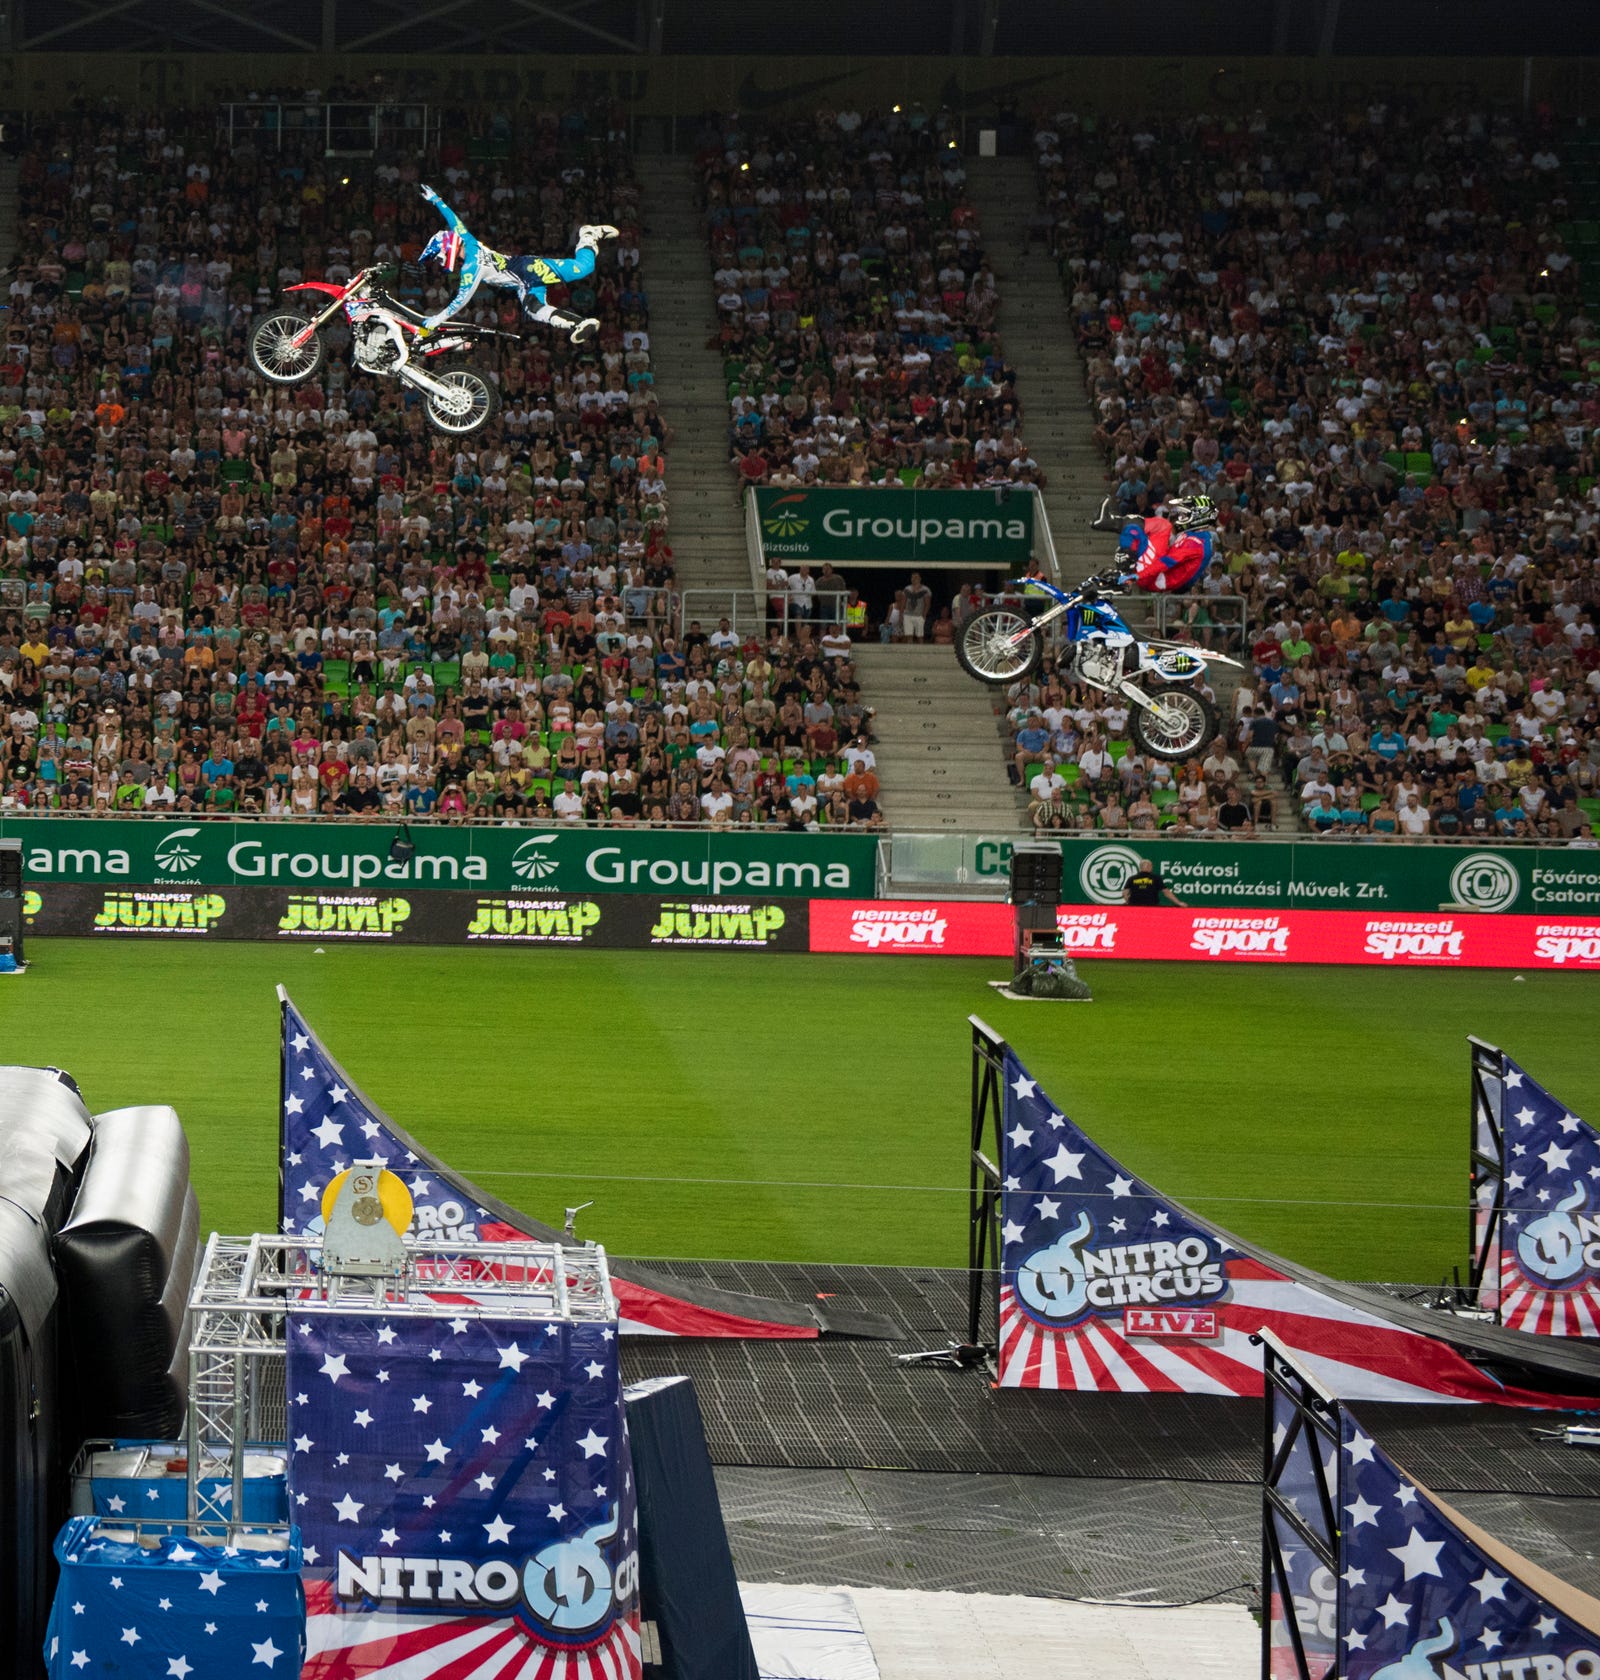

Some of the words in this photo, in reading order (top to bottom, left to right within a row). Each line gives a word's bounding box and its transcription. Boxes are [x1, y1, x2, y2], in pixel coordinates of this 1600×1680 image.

[368, 68, 648, 101] RADI.HU
[822, 509, 1026, 544] Groupama
[227, 840, 487, 887] Groupama
[585, 847, 850, 894] Groupama
[975, 842, 1012, 875] C
[1160, 860, 1239, 877] Fővárosi
[1532, 868, 1600, 885] Főváro
[1287, 881, 1350, 898] Művek
[1356, 882, 1389, 899] Zrt.
[1531, 886, 1600, 902] Csator
[852, 908, 938, 922] nemzeti
[1056, 912, 1108, 926] mzeti
[1193, 916, 1280, 930] nemzeti
[1366, 920, 1454, 933] nemzeti
[850, 918, 947, 947] sport
[1063, 921, 1118, 947] ort
[1190, 925, 1289, 956] sport
[1535, 925, 1600, 937] nemz
[1364, 931, 1464, 960] sport
[1533, 937, 1600, 963] spo
[1081, 1236, 1208, 1279] NITRO
[1086, 1263, 1223, 1307] CIRCUS
[1129, 1311, 1215, 1333] LIVE
[338, 1549, 519, 1602] NITRO
[615, 1550, 640, 1602] CIR
